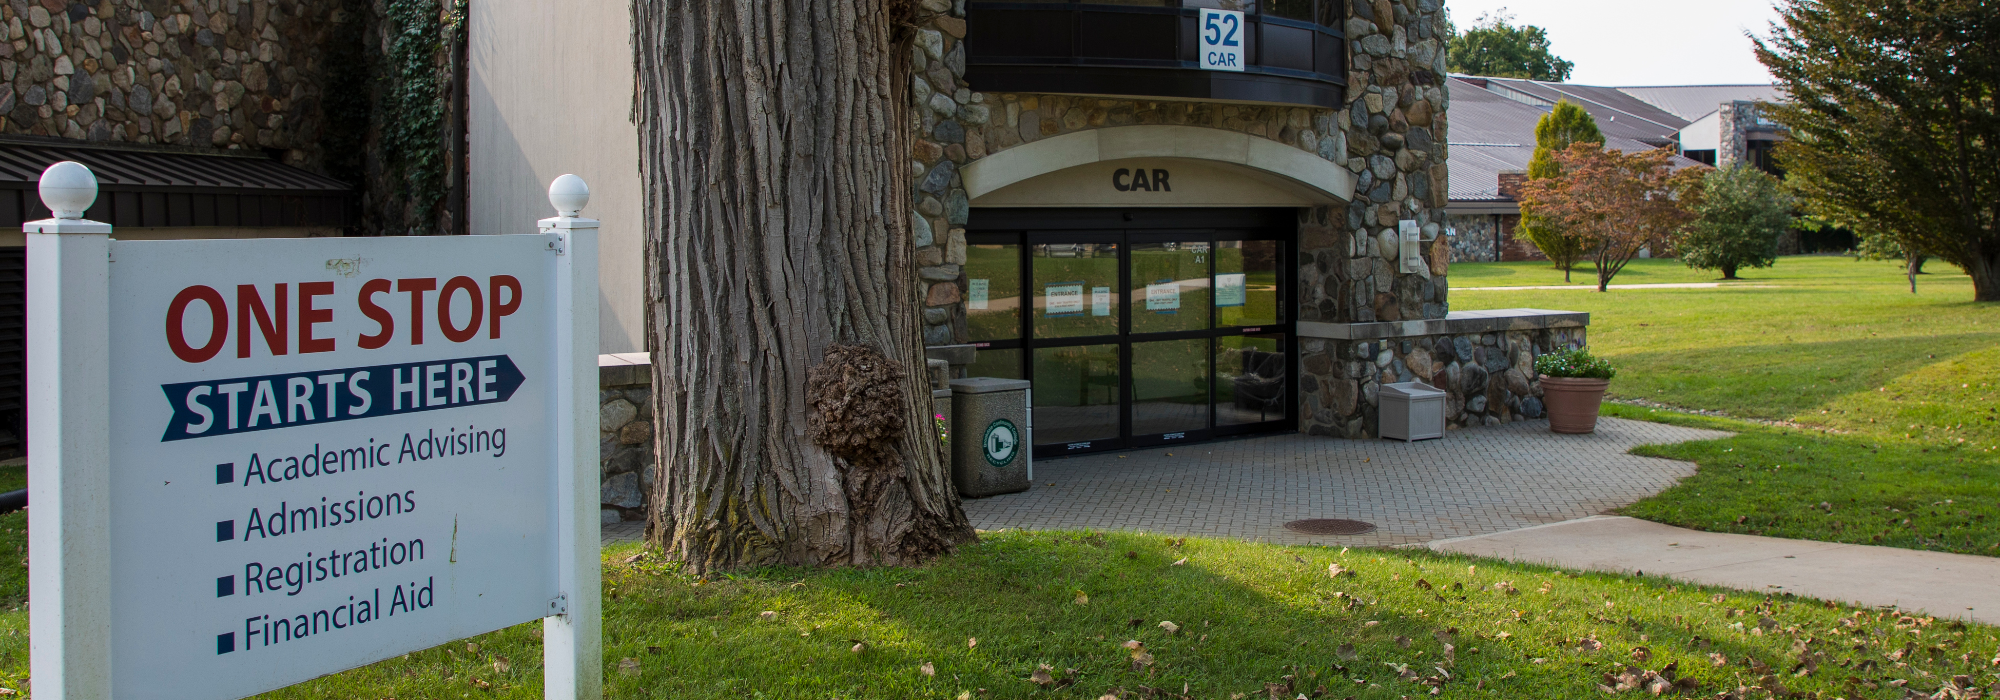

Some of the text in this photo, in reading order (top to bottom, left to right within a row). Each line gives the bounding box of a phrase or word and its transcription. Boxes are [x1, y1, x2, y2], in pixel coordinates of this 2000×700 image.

[1204, 13, 1240, 47] 52
[1208, 51, 1237, 67] CAR
[1112, 168, 1172, 192] CAR
[1191, 245, 1208, 254] CAR
[1195, 255, 1205, 264] A1
[165, 274, 523, 363] ONE STOP
[185, 360, 498, 435] STARTS HERE
[243, 424, 507, 487] Academic Advising
[243, 488, 416, 542] Admissions
[244, 537, 425, 597] Registration
[245, 576, 434, 651] Financial Aid
